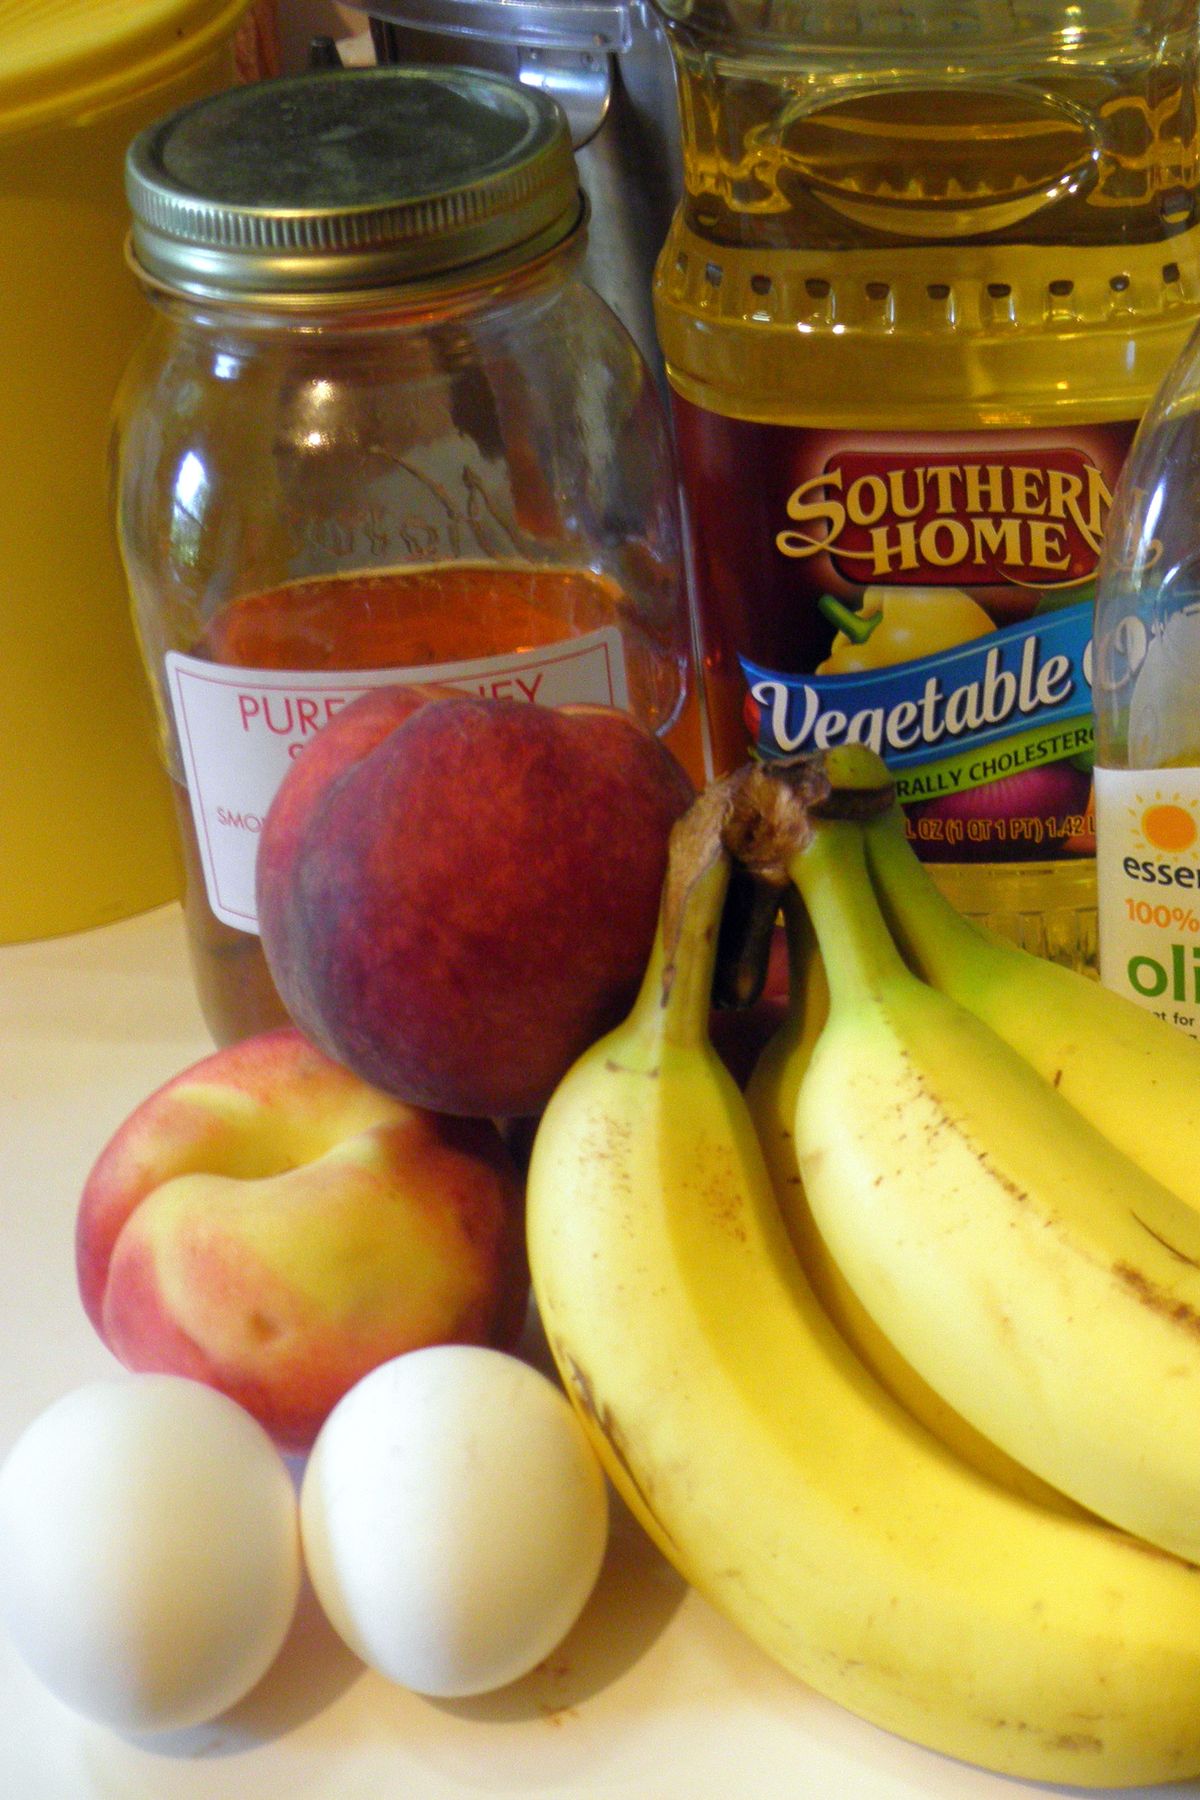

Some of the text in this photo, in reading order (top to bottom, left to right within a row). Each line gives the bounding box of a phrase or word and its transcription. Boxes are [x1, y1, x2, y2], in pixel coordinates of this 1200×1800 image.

[776, 464, 1114, 558] SOUTHERN
[871, 518, 1072, 576] HOME
[751, 635, 1072, 756] Vegetable
[896, 768, 963, 797] RALLY
[217, 807, 266, 833] SMO
[918, 817, 945, 841] OZ
[967, 818, 993, 842] QT
[1046, 815, 1085, 838] 1.42
[1124, 898, 1200, 934] 100%
[1173, 1012, 1195, 1027] for
